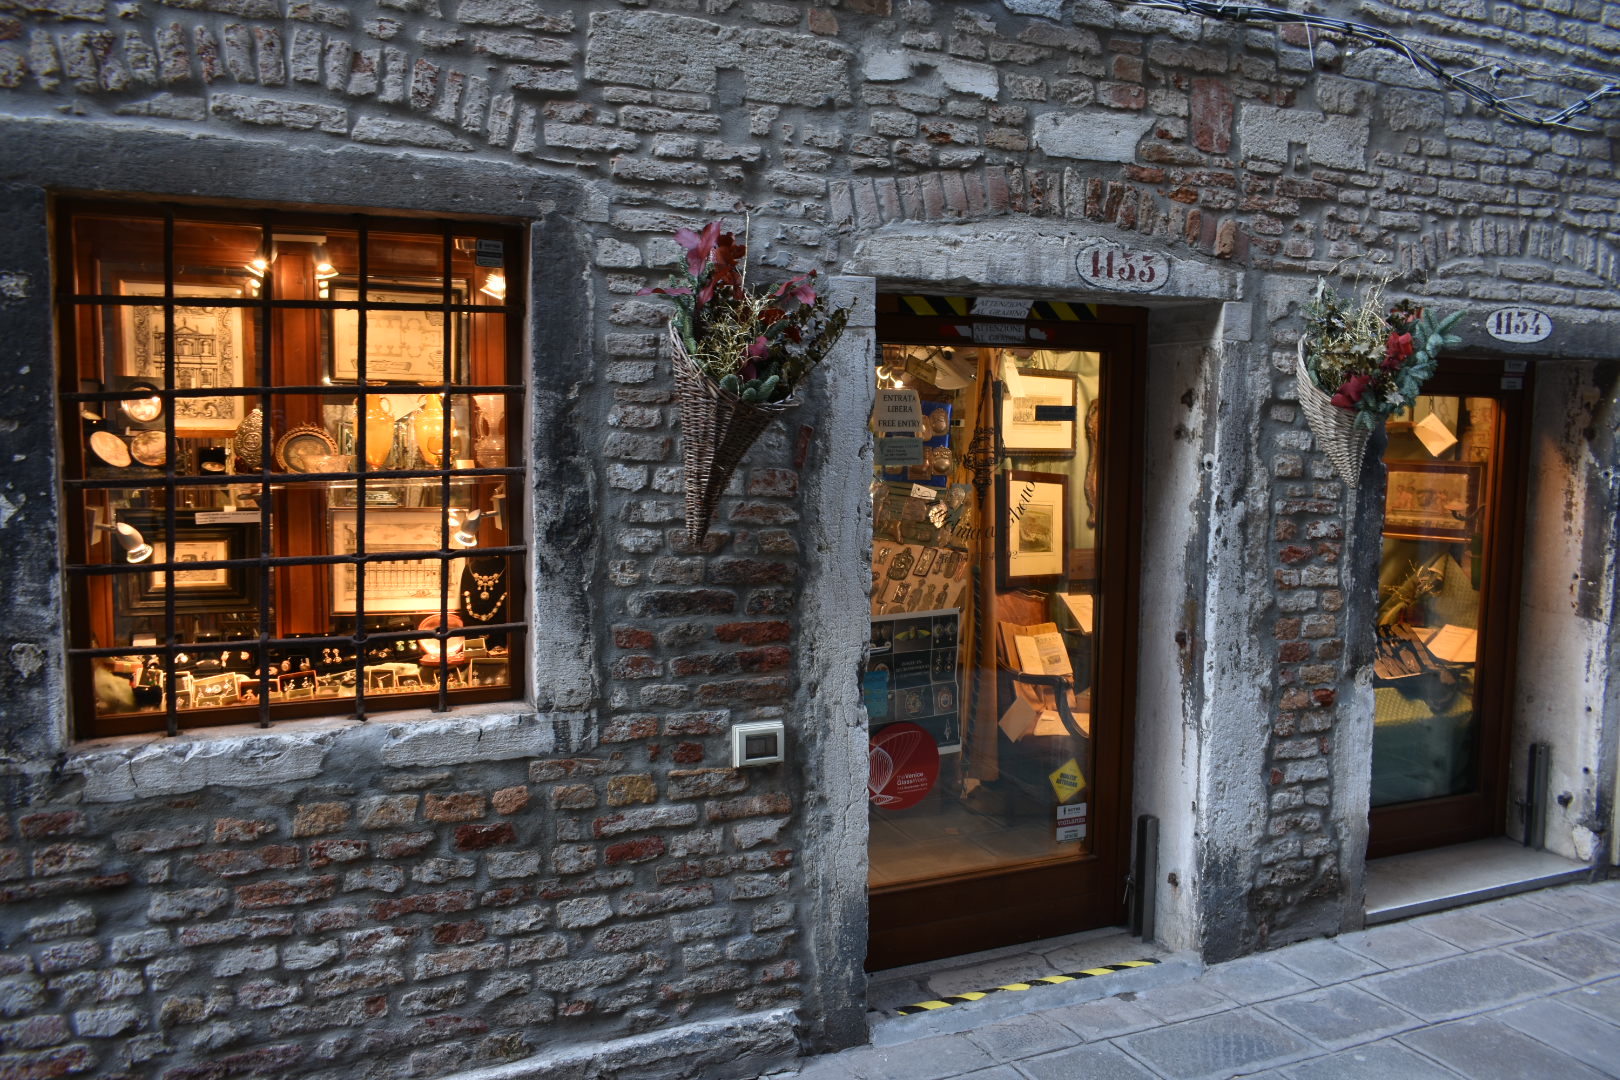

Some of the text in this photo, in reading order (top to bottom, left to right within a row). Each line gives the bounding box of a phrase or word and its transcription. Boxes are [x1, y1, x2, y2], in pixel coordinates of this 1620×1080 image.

[1091, 249, 1155, 283] 1133
[974, 324, 1024, 333] ATTENZIONE
[1495, 312, 1541, 336] 1134
[883, 394, 916, 402] ENTRATA
[887, 405, 913, 413] LIBERA
[878, 419, 920, 428] FREE ENTRY
